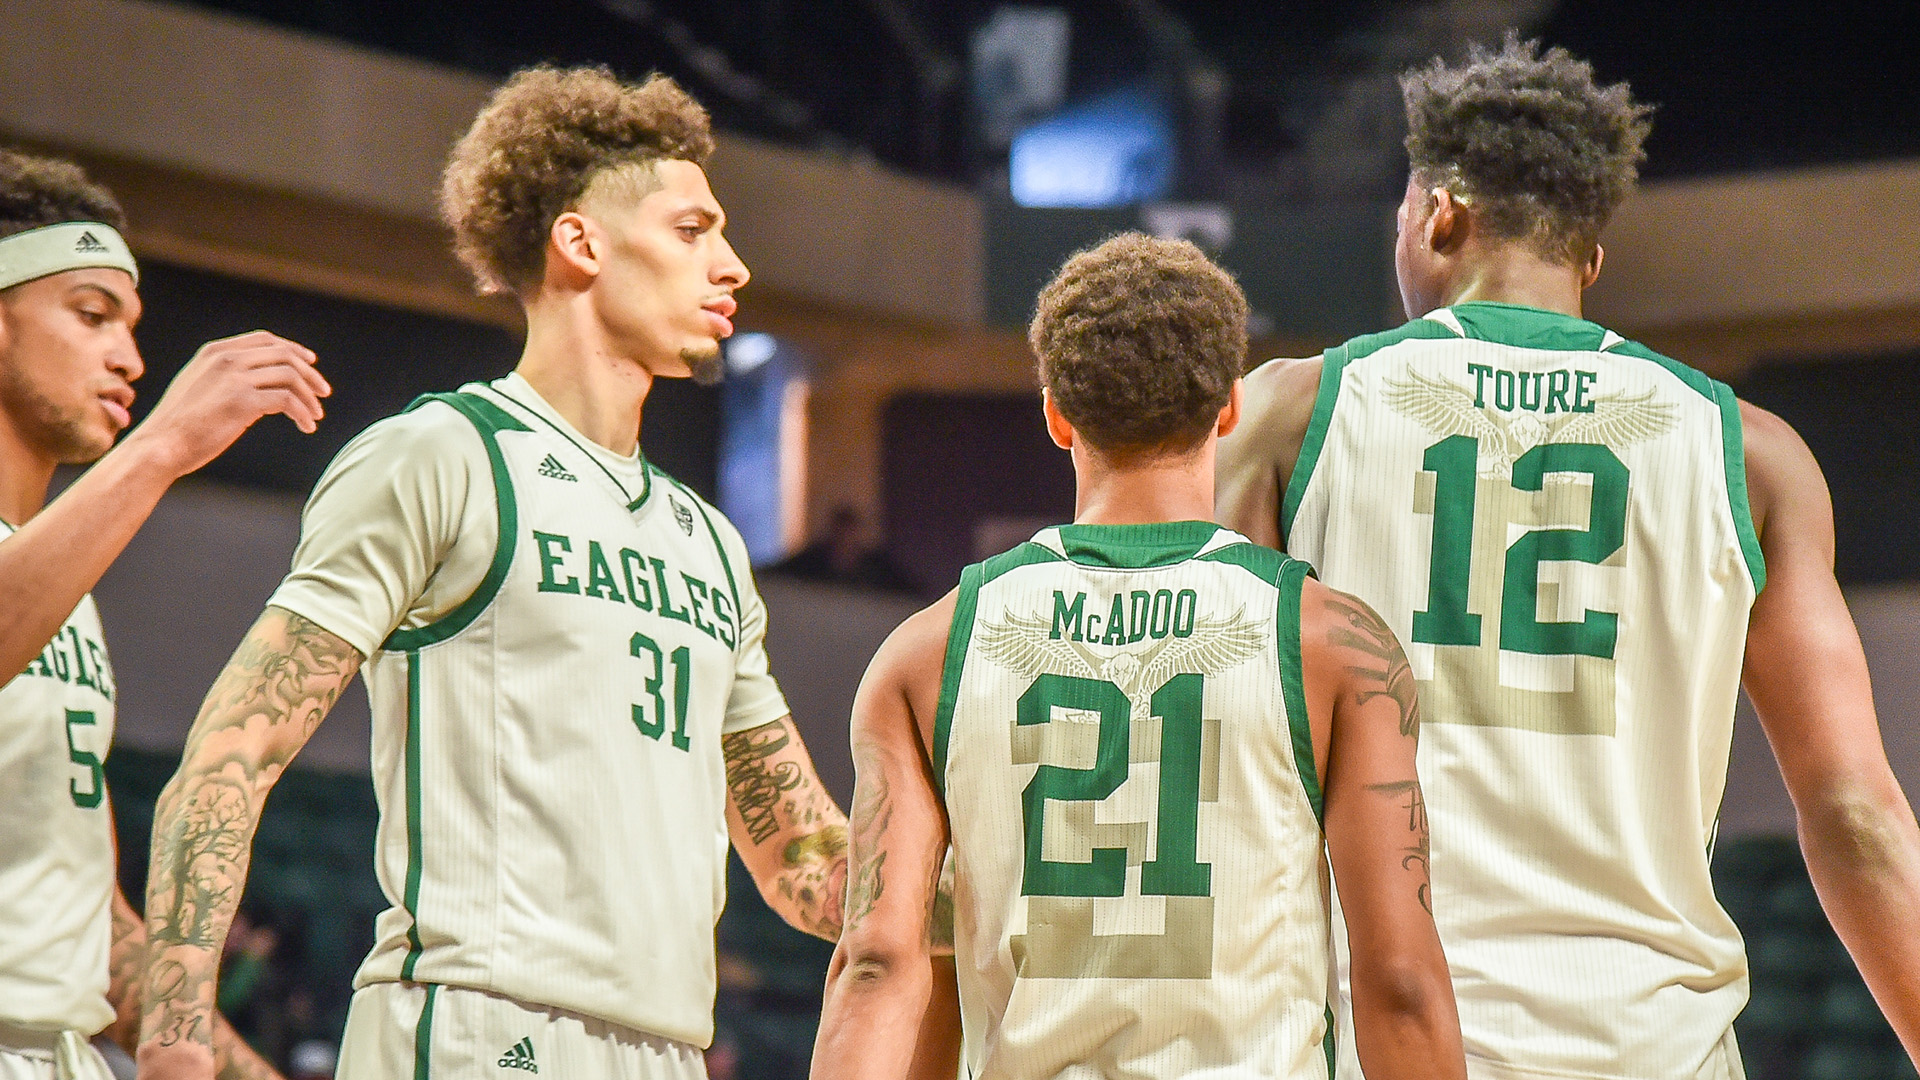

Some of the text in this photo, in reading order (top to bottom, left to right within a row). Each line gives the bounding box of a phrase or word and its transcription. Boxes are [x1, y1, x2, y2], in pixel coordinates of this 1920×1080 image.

[1467, 362, 1597, 414] TOURE
[533, 529, 736, 652] EAGLES
[1411, 433, 1630, 660] 12
[1049, 588, 1198, 646] McADOO
[630, 631, 690, 753] 31
[64, 708, 103, 809] 5
[1016, 672, 1212, 898] 21
